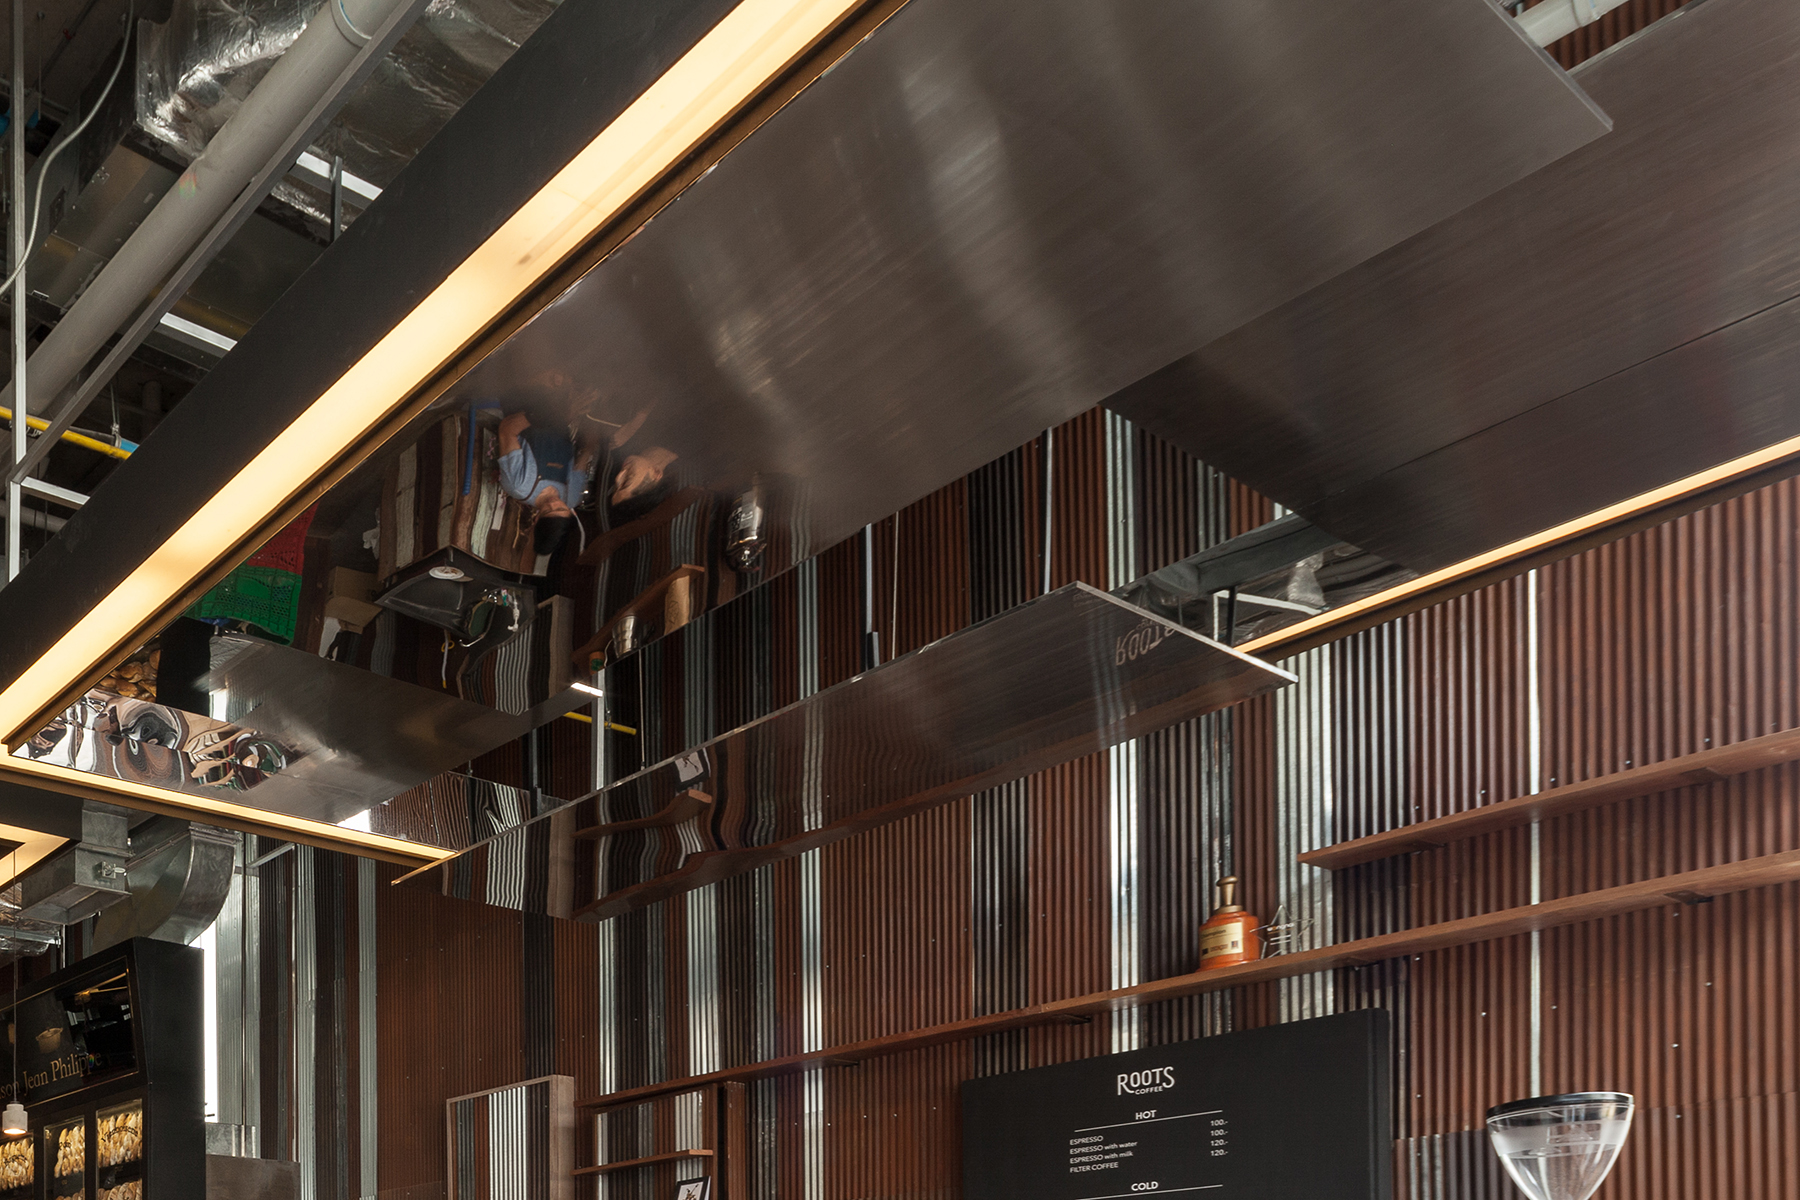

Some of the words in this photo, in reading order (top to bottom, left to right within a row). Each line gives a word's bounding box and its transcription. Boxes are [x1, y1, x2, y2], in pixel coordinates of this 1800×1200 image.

[23, 1071, 49, 1096] Jean
[50, 1052, 101, 1081] Philippe
[1117, 1066, 1175, 1096] ROOTS
[1134, 1085, 1163, 1095] COFFEE
[1135, 1109, 1157, 1120] HOT
[1069, 1135, 1104, 1146] ESPRESSO
[1069, 1144, 1104, 1155] ESPRESSO
[1119, 1140, 1138, 1148] water
[1069, 1154, 1104, 1164] ESPRESSO
[1119, 1150, 1134, 1158] milk
[1069, 1165, 1091, 1173] FILTER
[1091, 1162, 1119, 1171] COFFEE
[1131, 1181, 1159, 1191] COLD
